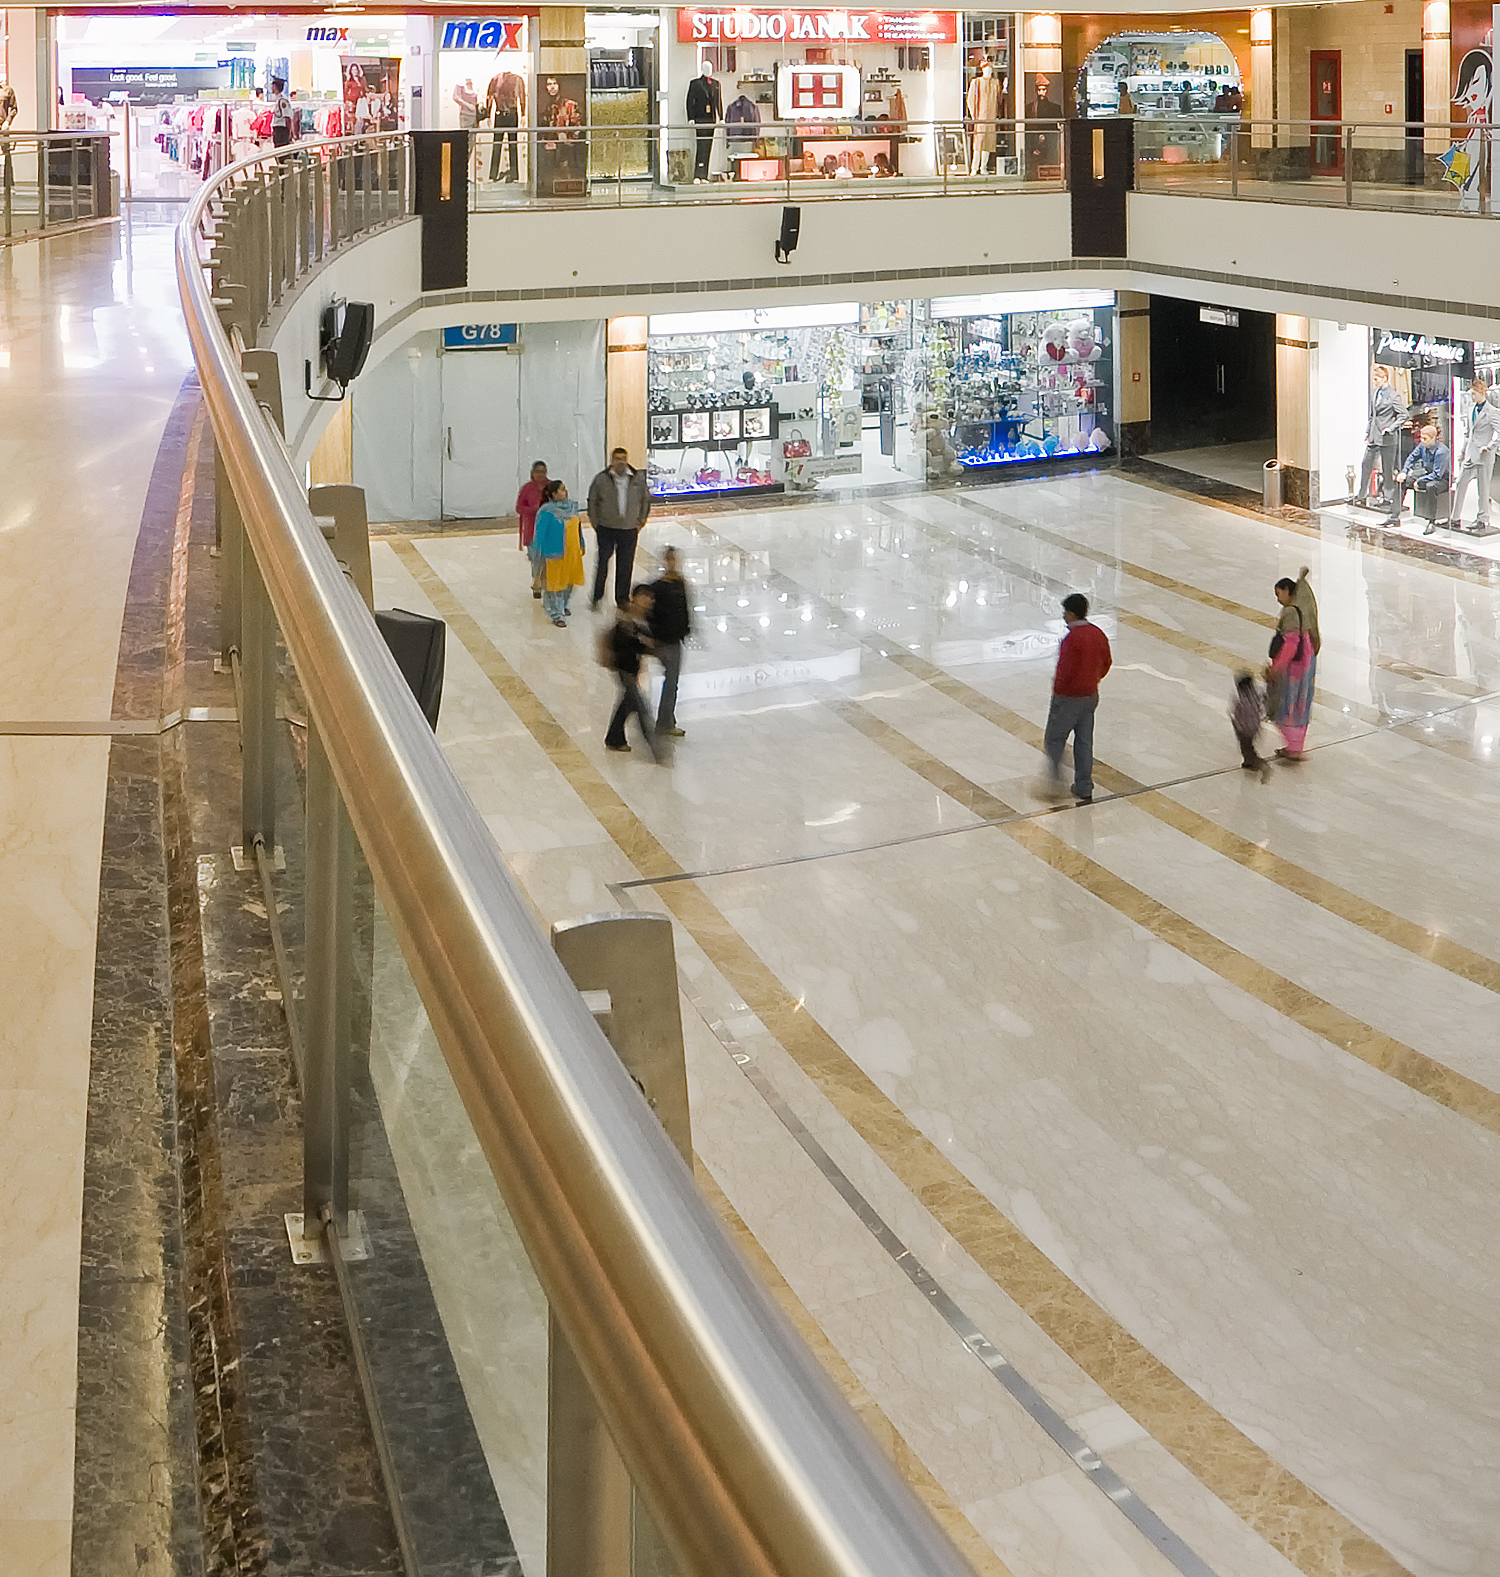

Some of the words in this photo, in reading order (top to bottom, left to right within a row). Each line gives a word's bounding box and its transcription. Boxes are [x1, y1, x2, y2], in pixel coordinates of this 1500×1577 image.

[306, 27, 350, 47] max
[441, 20, 524, 58] max
[692, 13, 788, 40] STUDIO
[789, 12, 871, 41] JANAK
[461, 324, 502, 340] G78
[1376, 332, 1416, 355] Park
[1414, 335, 1465, 362] Avenue
